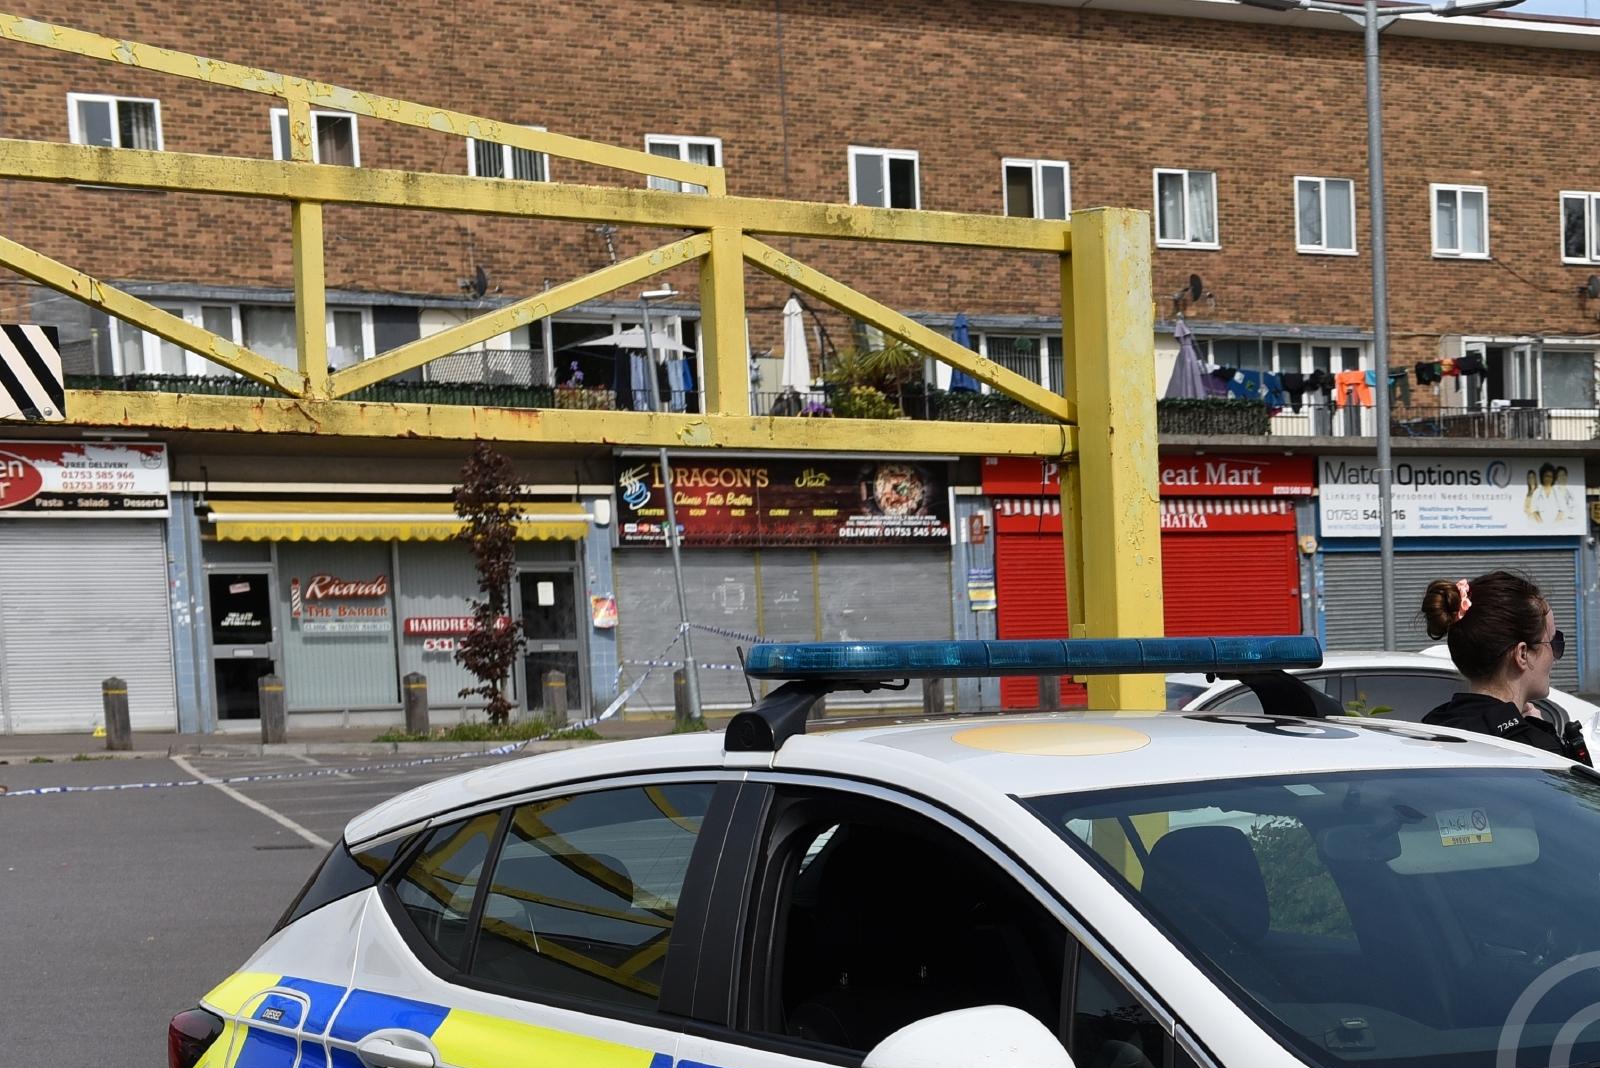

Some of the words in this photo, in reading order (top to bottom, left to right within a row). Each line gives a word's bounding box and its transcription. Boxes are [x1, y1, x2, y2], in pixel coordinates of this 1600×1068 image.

[89, 461, 128, 469] DELIVERY
[61, 471, 92, 479] 01753
[652, 463, 769, 488] DRAGON'S
[1158, 468, 1200, 485] eat
[1205, 463, 1262, 485] Mart
[62, 482, 93, 490] 01753
[35, 498, 64, 508] Pasta
[77, 498, 109, 508] Salads
[123, 497, 165, 508] Desserts
[1326, 509, 1359, 520] 01753
[884, 527, 911, 537] 01753
[306, 575, 387, 599] Ricardo
[1498, 718, 1519, 732] 7263
